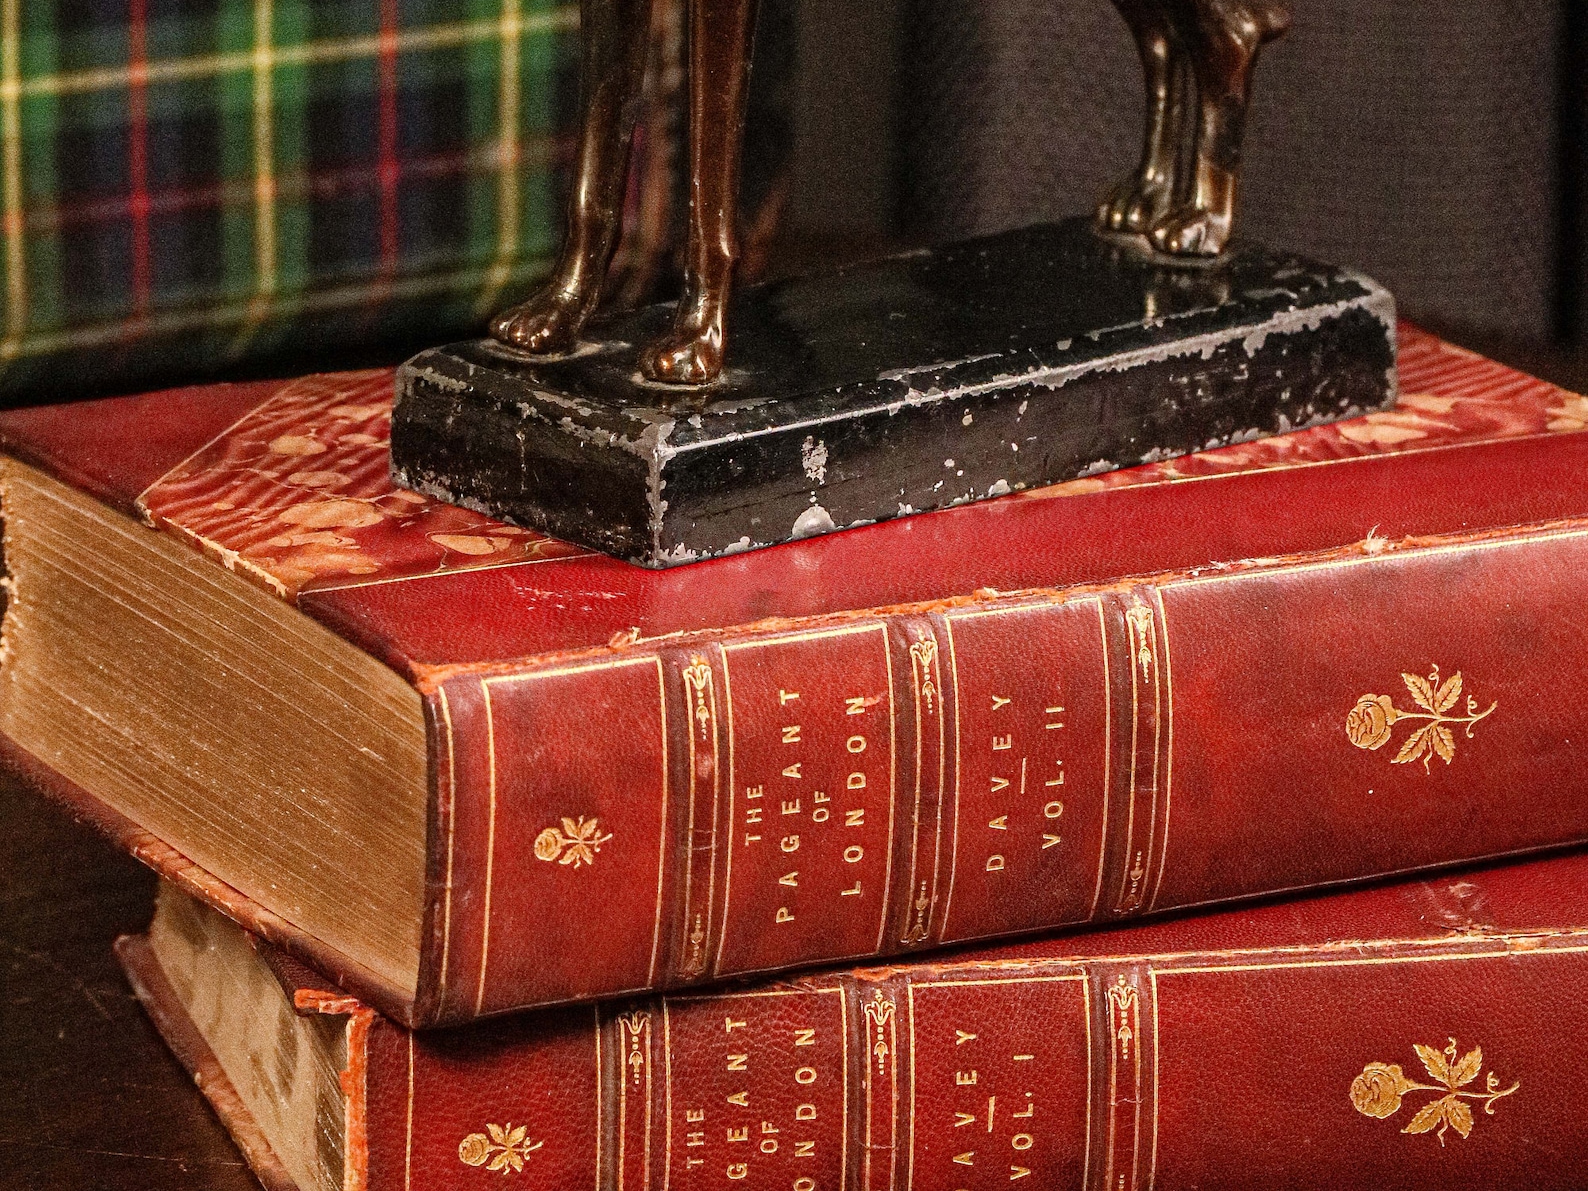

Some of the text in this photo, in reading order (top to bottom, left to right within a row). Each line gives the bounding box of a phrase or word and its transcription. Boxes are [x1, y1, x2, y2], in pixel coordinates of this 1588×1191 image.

[745, 785, 763, 846] THE
[776, 689, 802, 924] PAGEANT
[812, 790, 831, 823] OF
[841, 696, 867, 896] LONDON
[986, 695, 1012, 872] DAVEY
[1042, 706, 1065, 849] VOL. II
[686, 1109, 705, 1169] THE
[725, 1017, 749, 1180] GEANT
[760, 1121, 779, 1154] OF
[793, 1028, 817, 1191] ONDON
[953, 1029, 978, 1191] AVEY
[1010, 1092, 1034, 1181] VOL.
